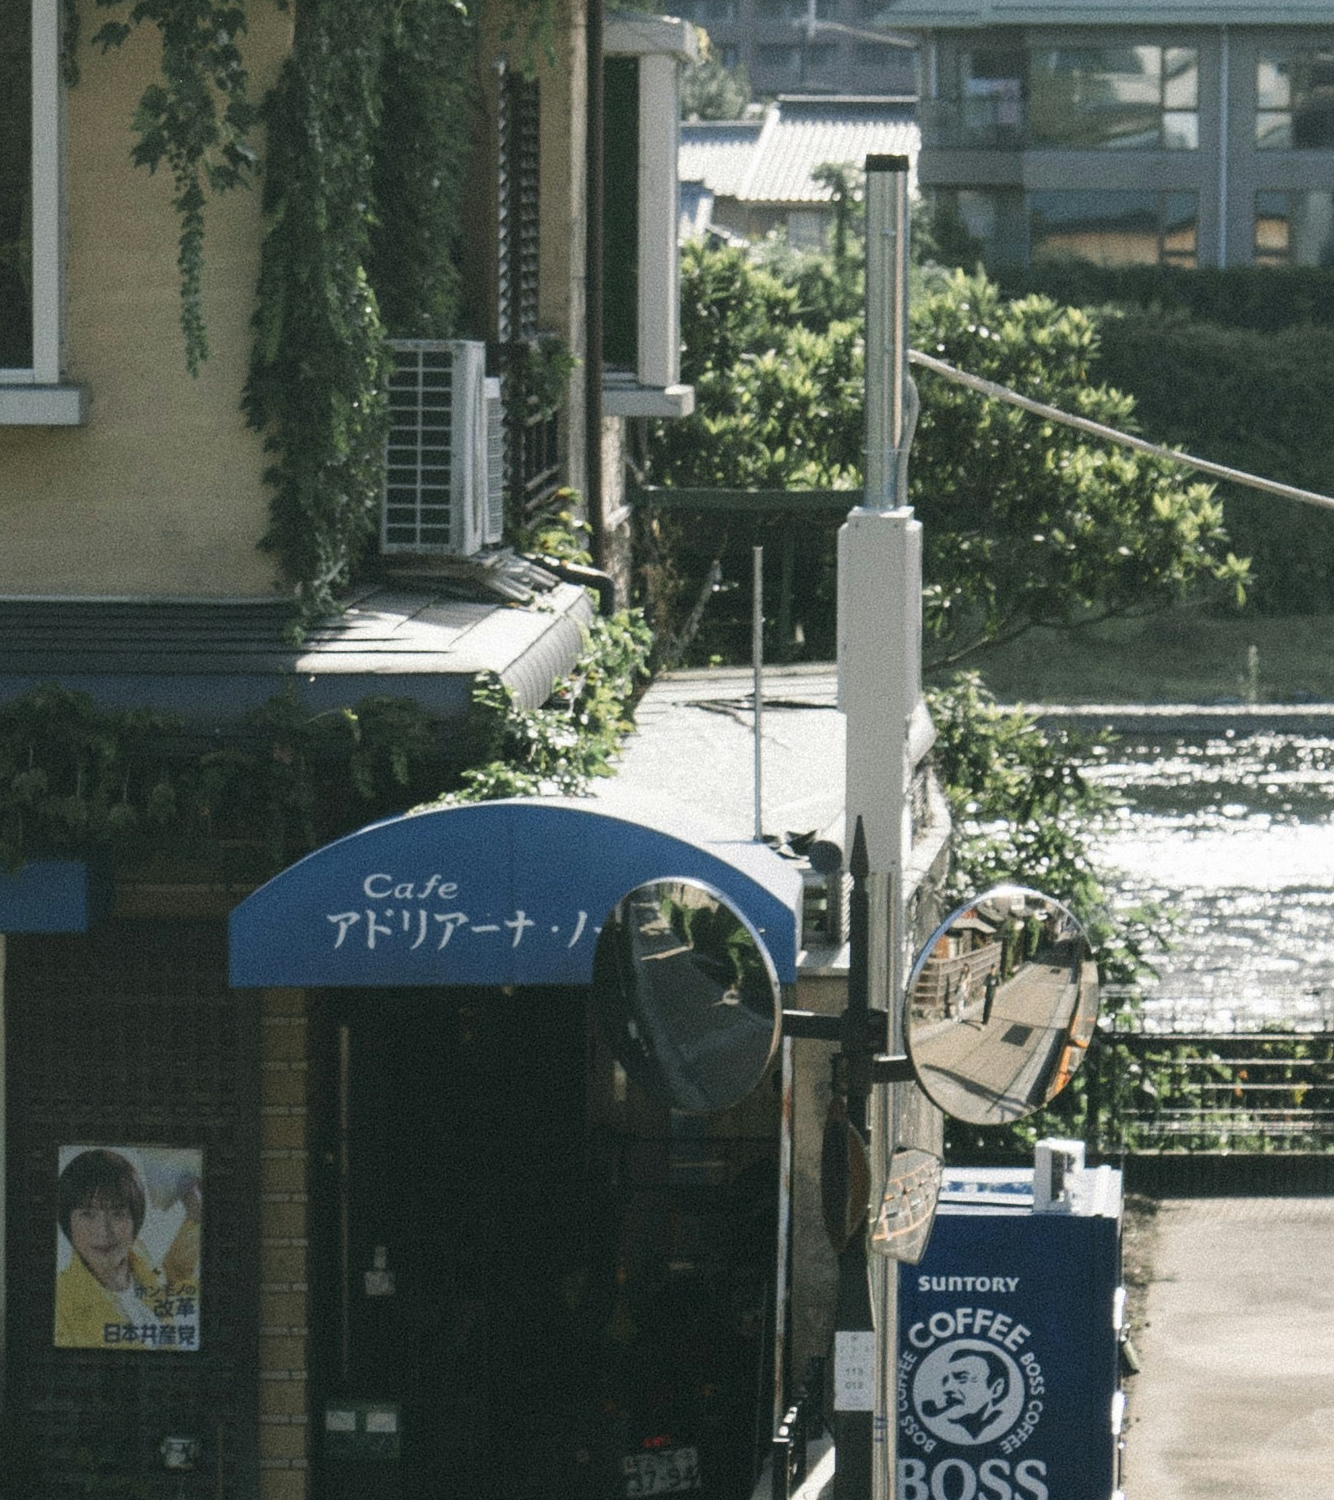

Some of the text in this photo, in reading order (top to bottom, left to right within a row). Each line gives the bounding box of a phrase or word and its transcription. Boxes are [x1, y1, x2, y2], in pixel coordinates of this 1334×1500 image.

[361, 872, 460, 901] Cafe
[325, 907, 603, 951] アドリアーナ・ノ
[916, 1274, 1020, 1293] SUNTORY
[154, 1298, 197, 1317] 改革
[103, 1323, 196, 1345] 日本共産党
[907, 1307, 1032, 1352] COFFEE
[999, 1351, 1046, 1455] BOSS COFFEE
